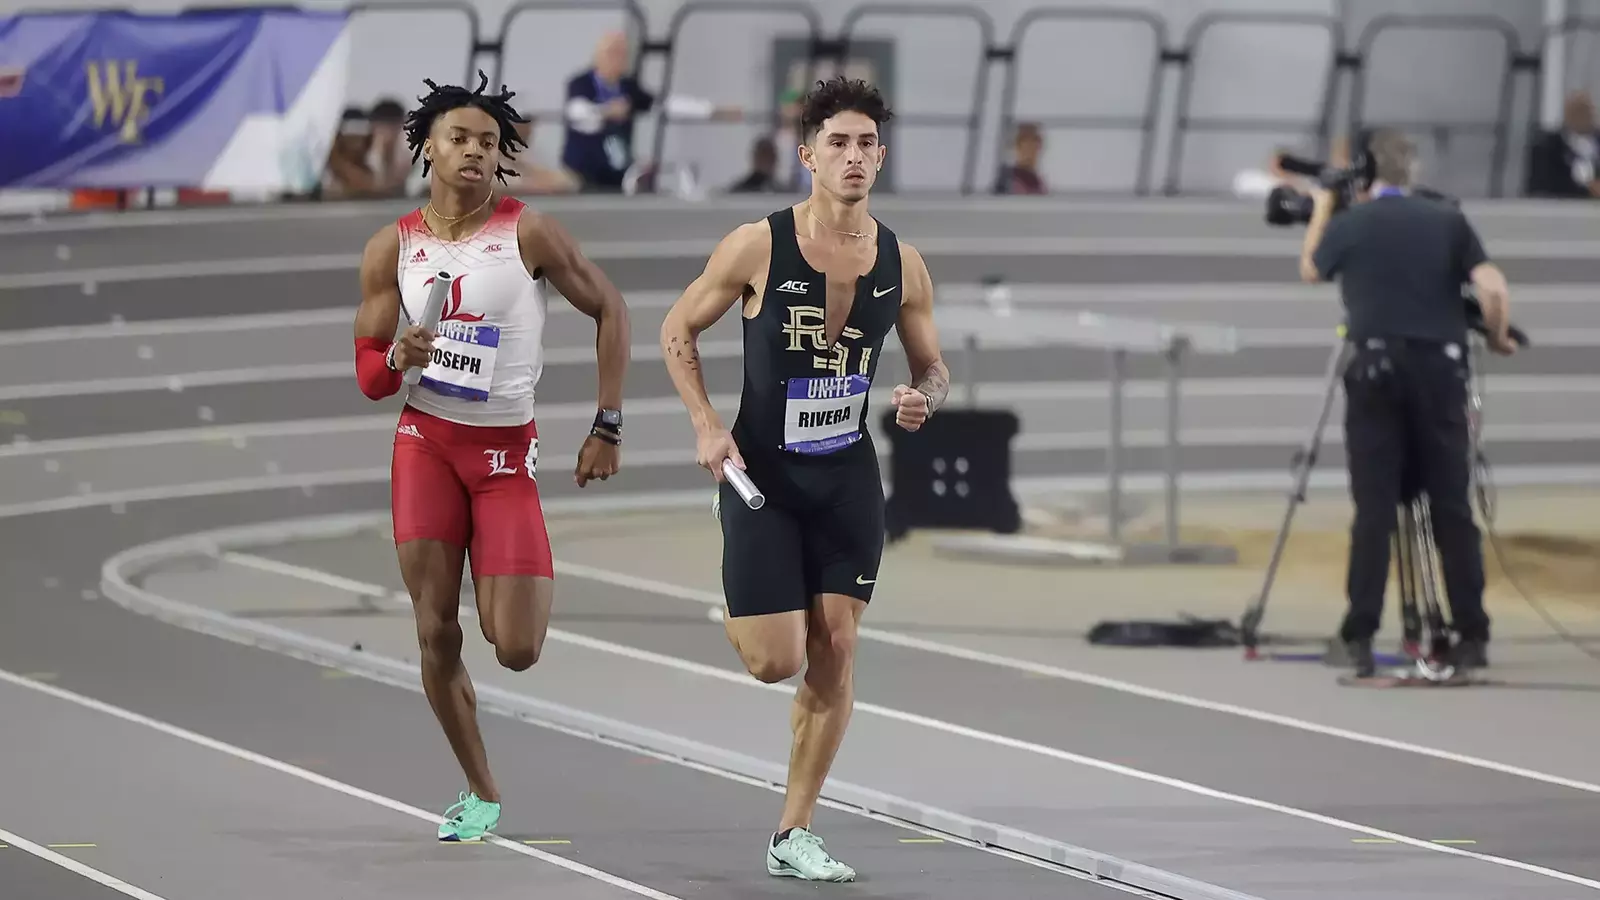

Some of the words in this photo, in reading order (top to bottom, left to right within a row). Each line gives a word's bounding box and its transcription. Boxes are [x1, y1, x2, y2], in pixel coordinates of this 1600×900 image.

[777, 280, 810, 294] ACC
[431, 348, 481, 375] OSEPH
[808, 377, 852, 398] UNITE
[799, 406, 851, 428] RIVERA
[484, 449, 517, 476] L
